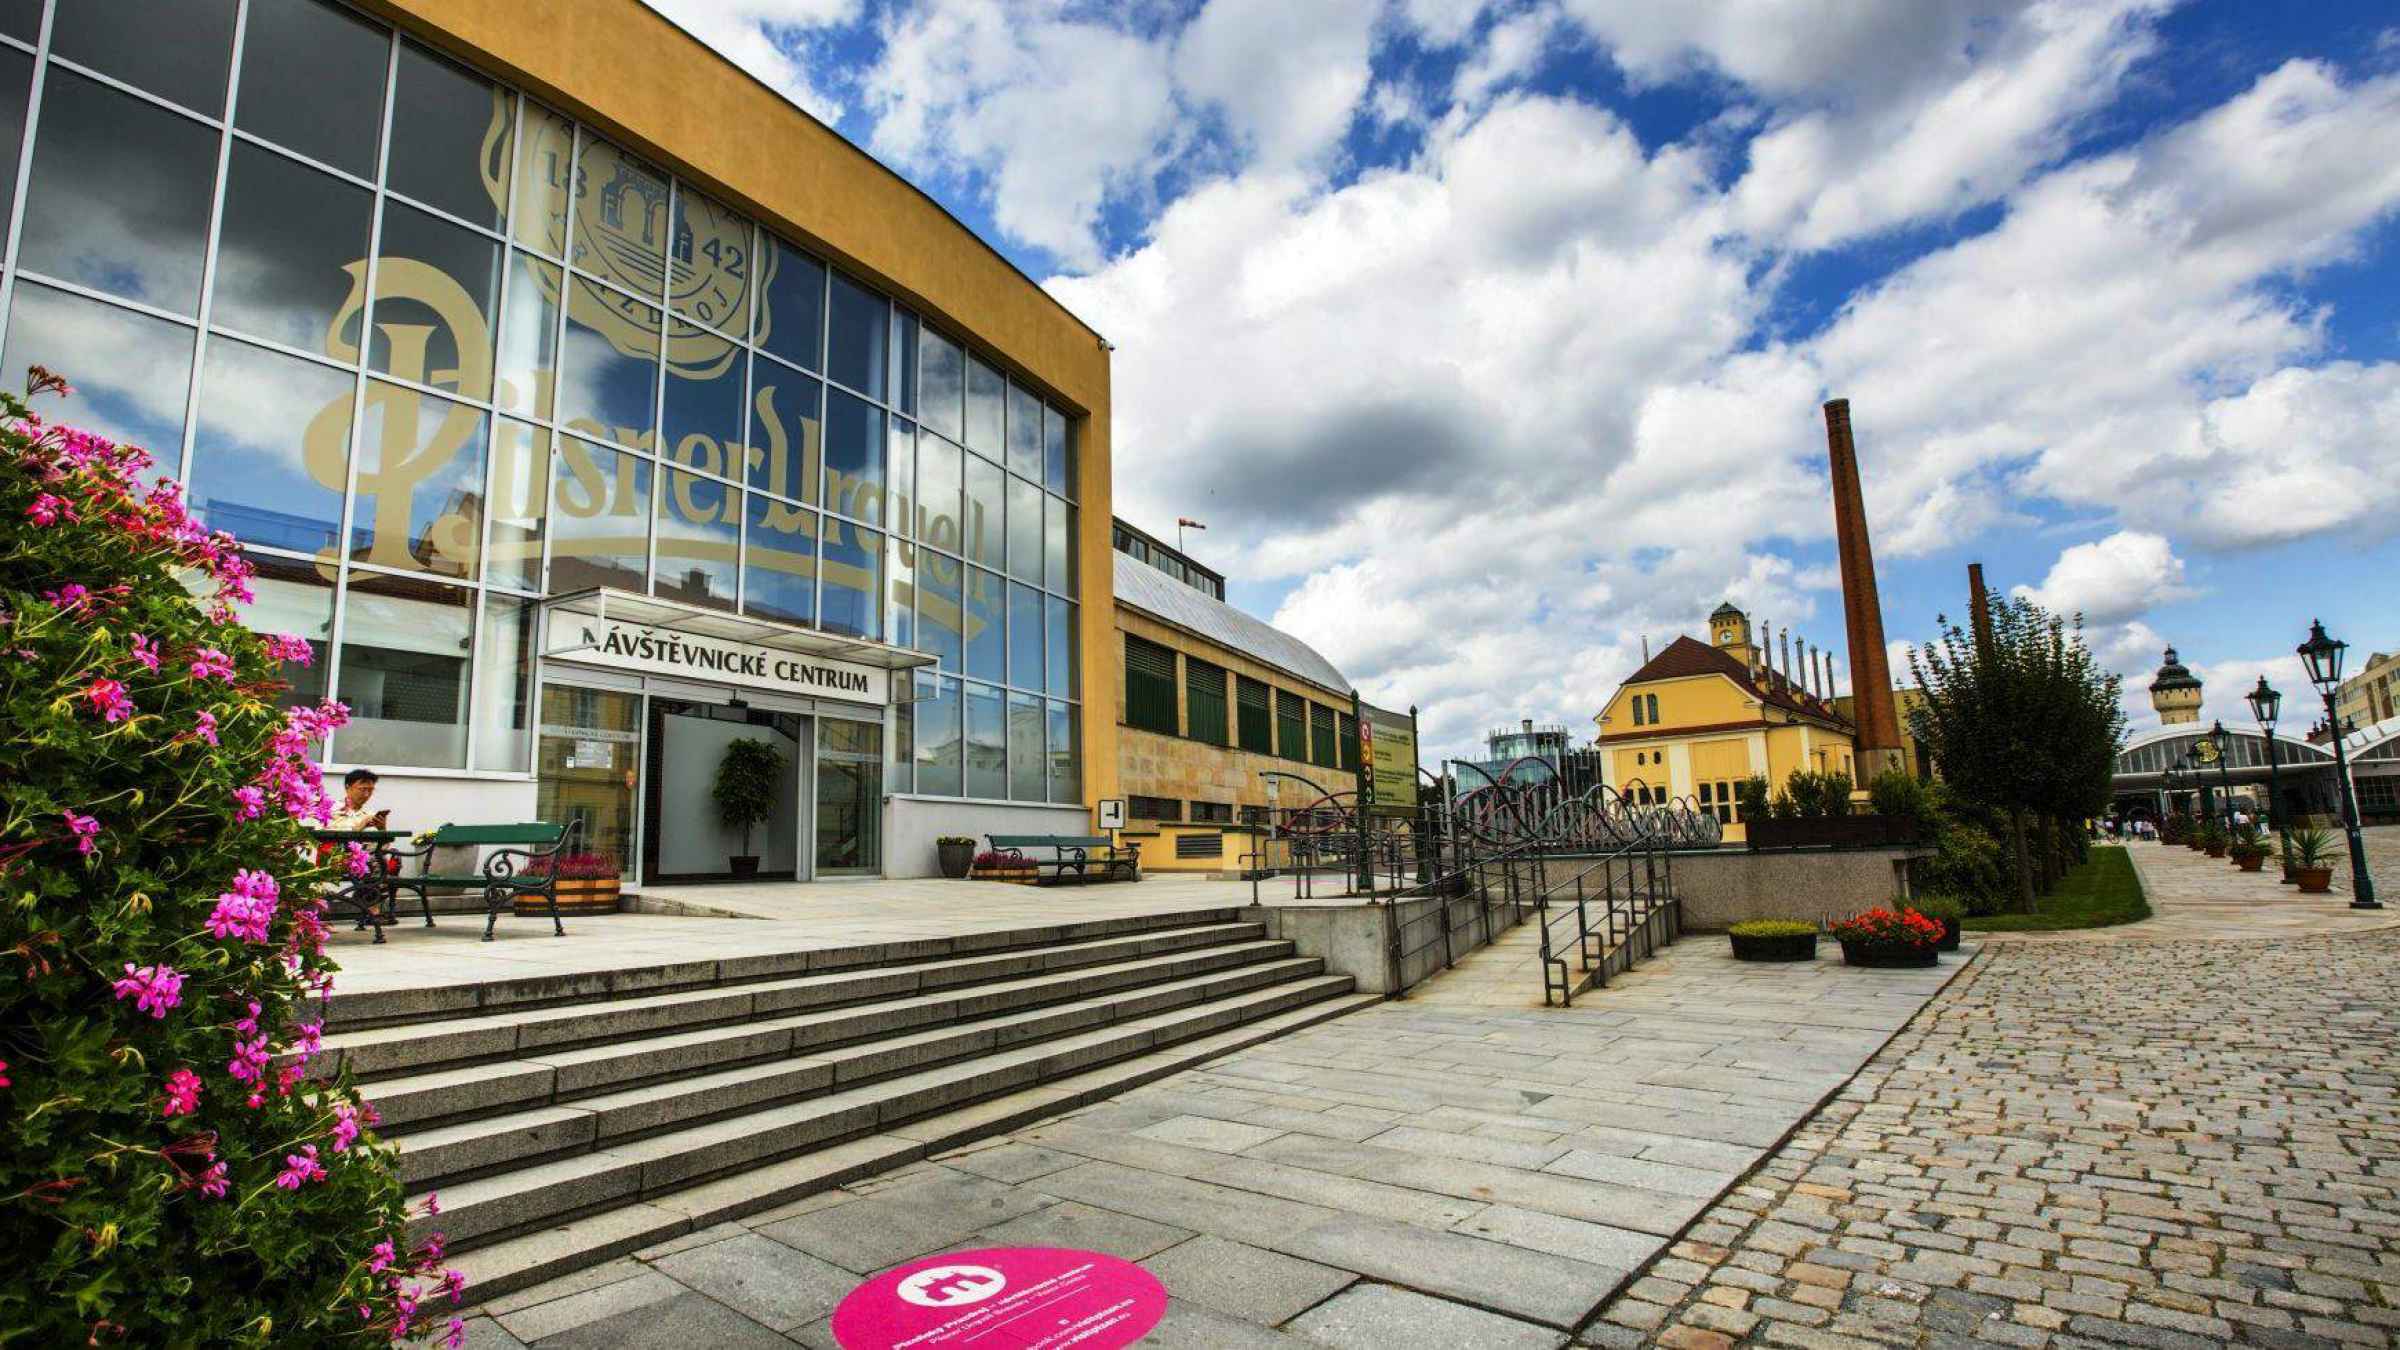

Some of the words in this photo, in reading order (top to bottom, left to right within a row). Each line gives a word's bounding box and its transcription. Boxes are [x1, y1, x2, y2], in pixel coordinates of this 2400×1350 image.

[303, 257, 764, 584] Pilsner
[582, 625, 768, 678] NÁVŠTĚVNICKÉ
[775, 660, 869, 693] CENTRUM
